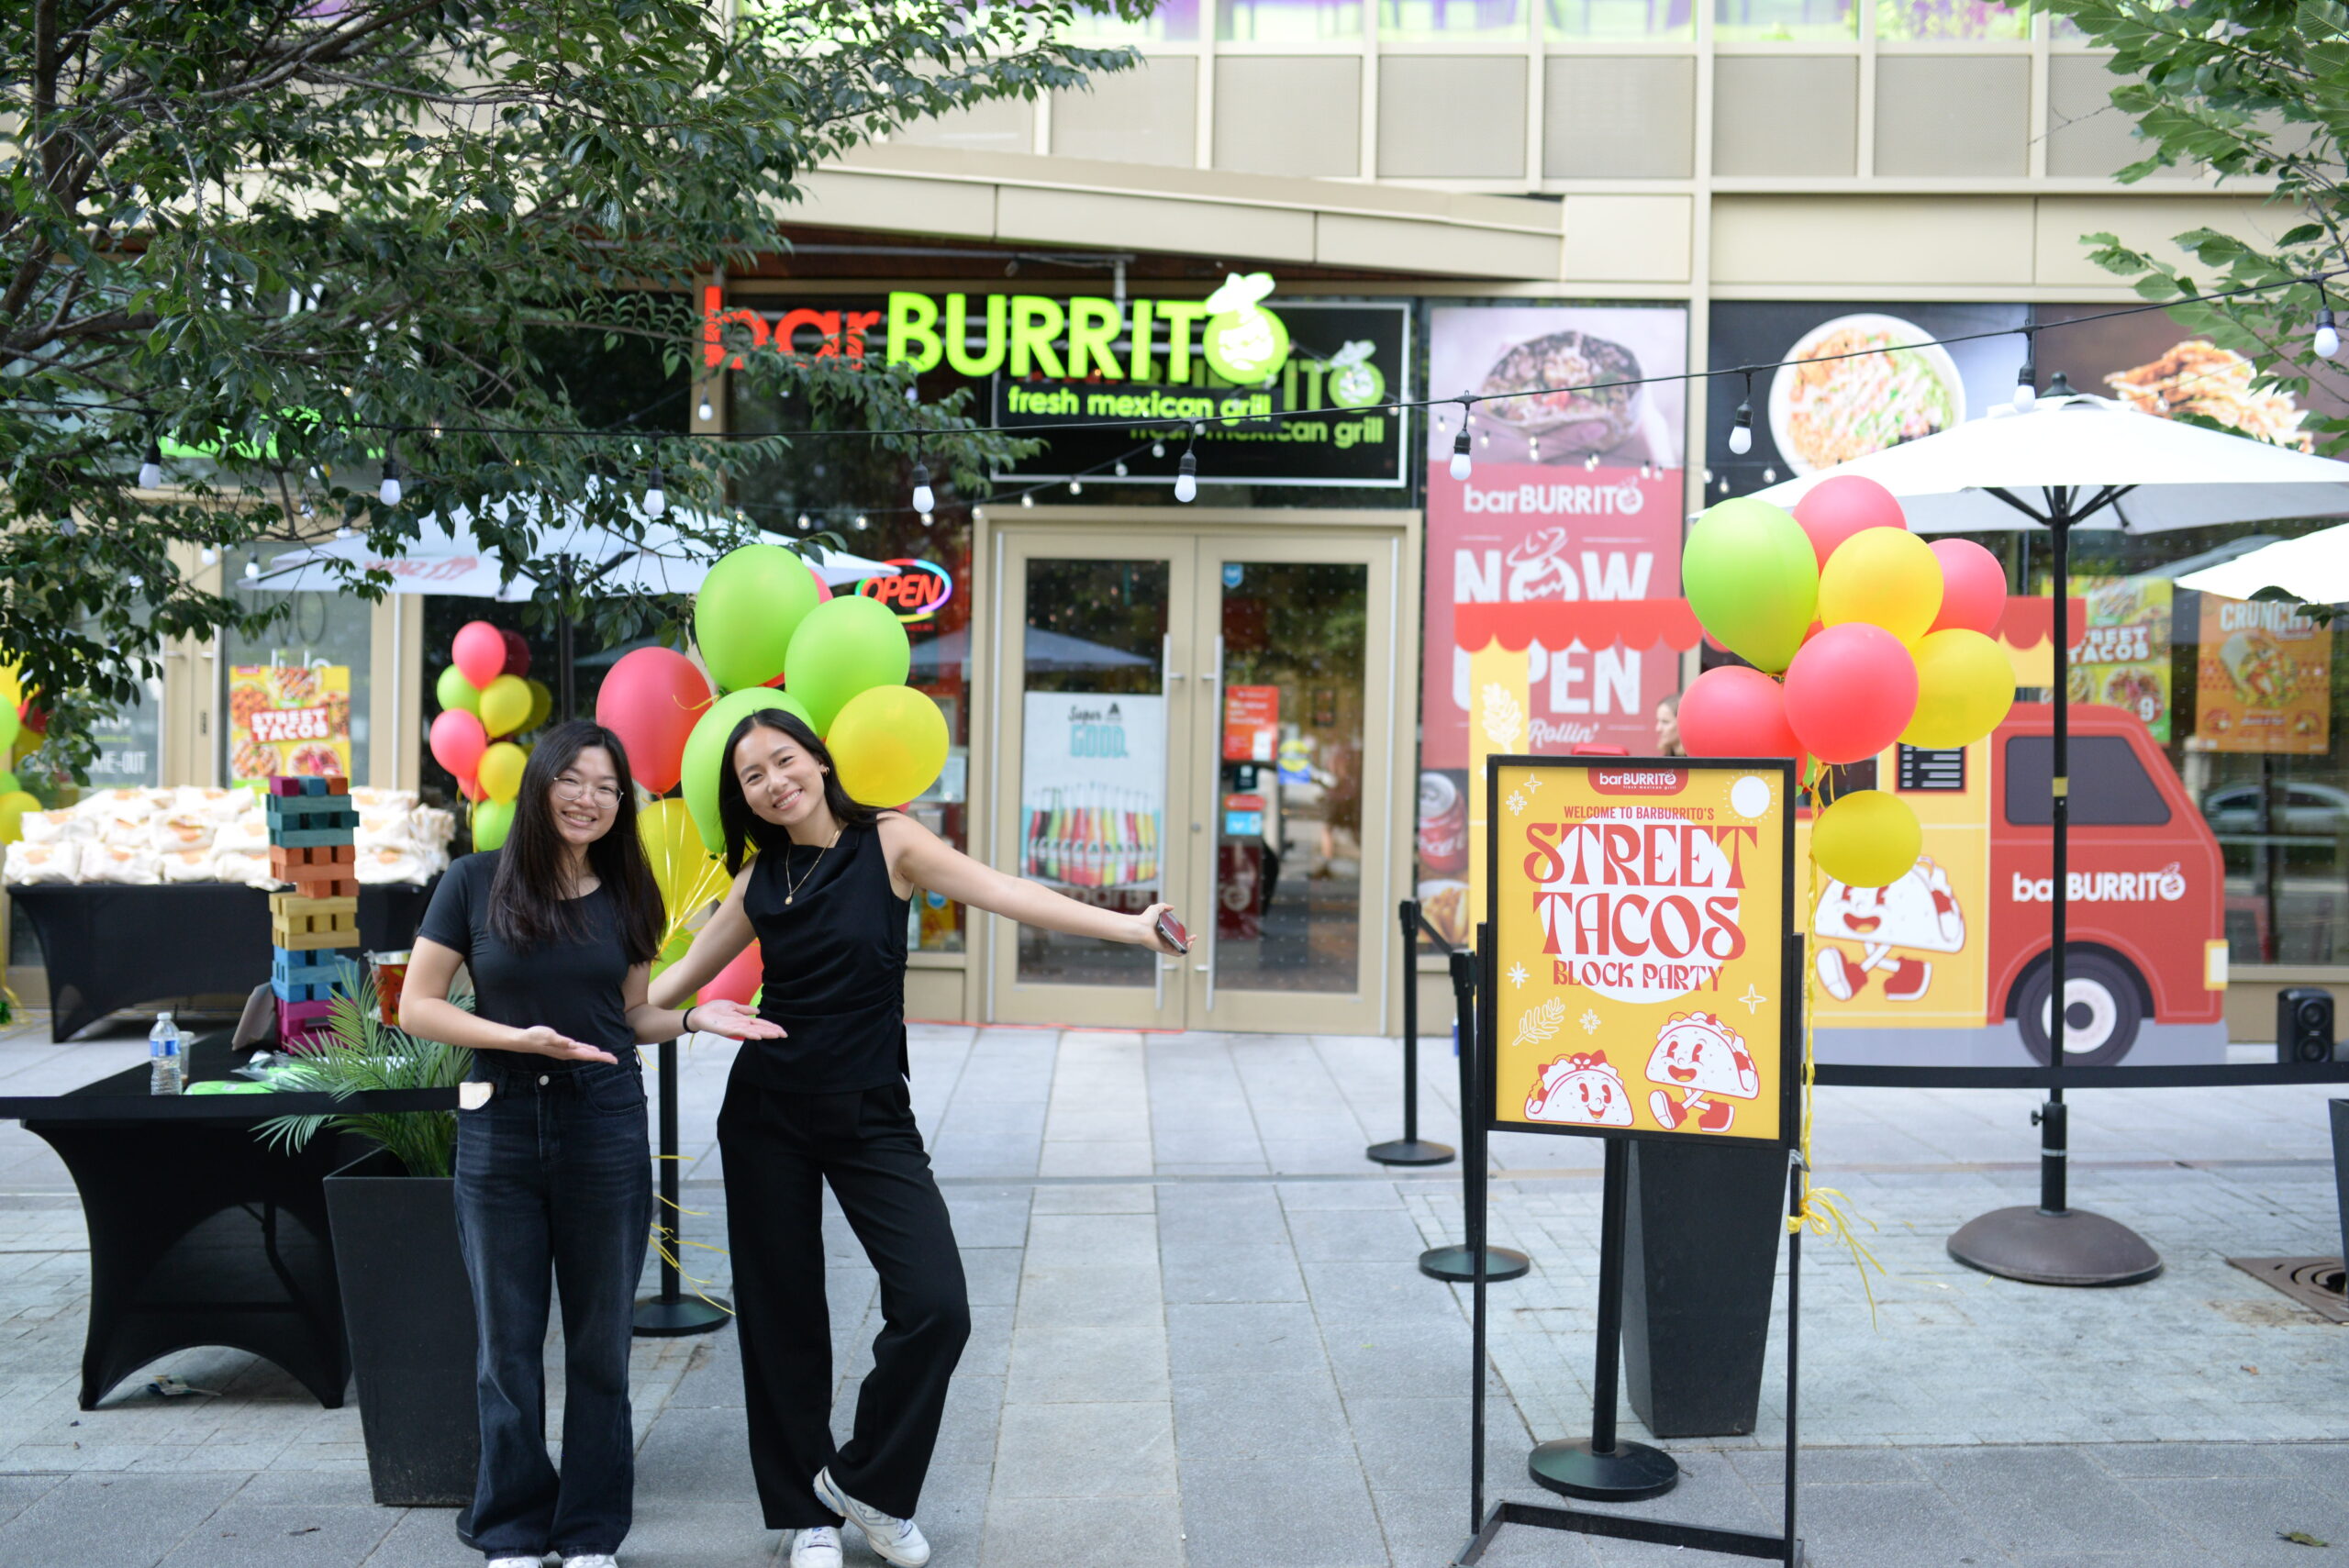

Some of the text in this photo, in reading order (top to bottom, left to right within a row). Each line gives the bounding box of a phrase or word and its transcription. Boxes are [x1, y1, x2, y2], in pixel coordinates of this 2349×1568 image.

[1008, 385, 1273, 428] fresh mexican grill
[1463, 482, 1644, 516] barBURRITO
[861, 573, 942, 607] OPEN
[2068, 641, 2150, 662] TACOS
[250, 707, 328, 727] STREET
[252, 723, 329, 743] TACOS
[1599, 773, 1677, 785] barBURRITO
[1564, 806, 1714, 820] WELCOME TO BARBURRITO'S
[1523, 822, 1758, 889] STREET
[2012, 871, 2187, 902] baBURRITO
[1533, 891, 1746, 961] TACOS
[1553, 960, 1724, 992] BLOCK PARTY
